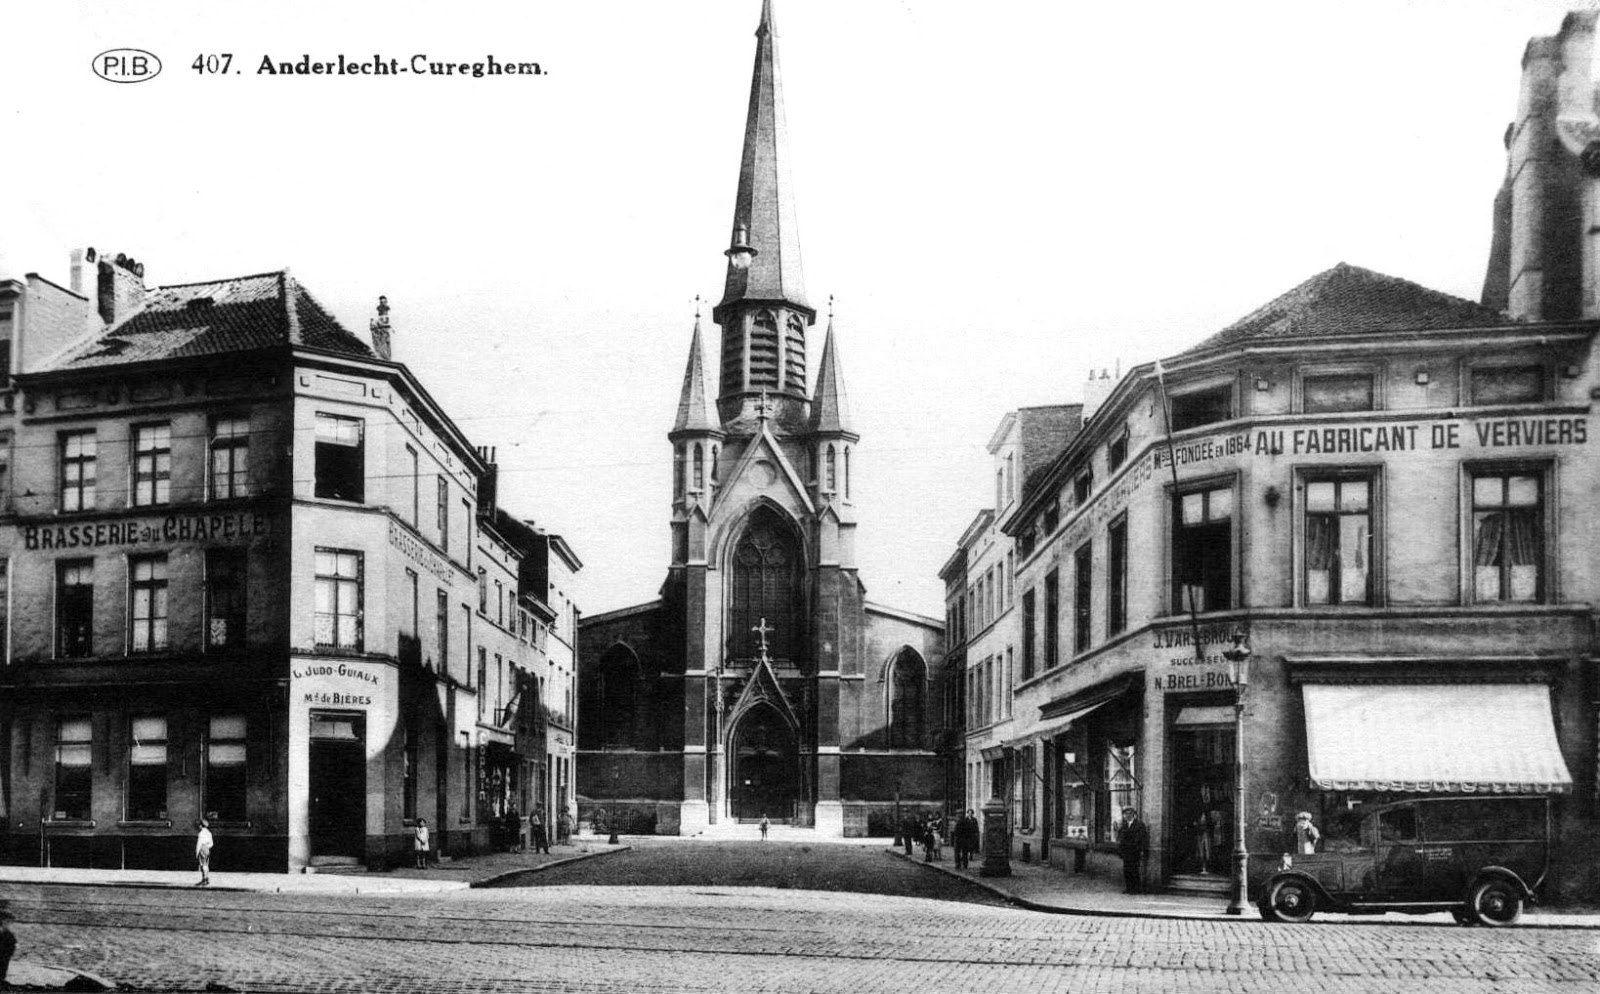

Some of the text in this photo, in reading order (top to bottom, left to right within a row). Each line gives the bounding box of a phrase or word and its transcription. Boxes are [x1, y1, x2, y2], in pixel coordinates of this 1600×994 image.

[1226, 434, 1252, 456] 1864
[1255, 419, 1587, 455] AU FABRICANT DE VERVIERS
[25, 522, 139, 550] BRASSERIE
